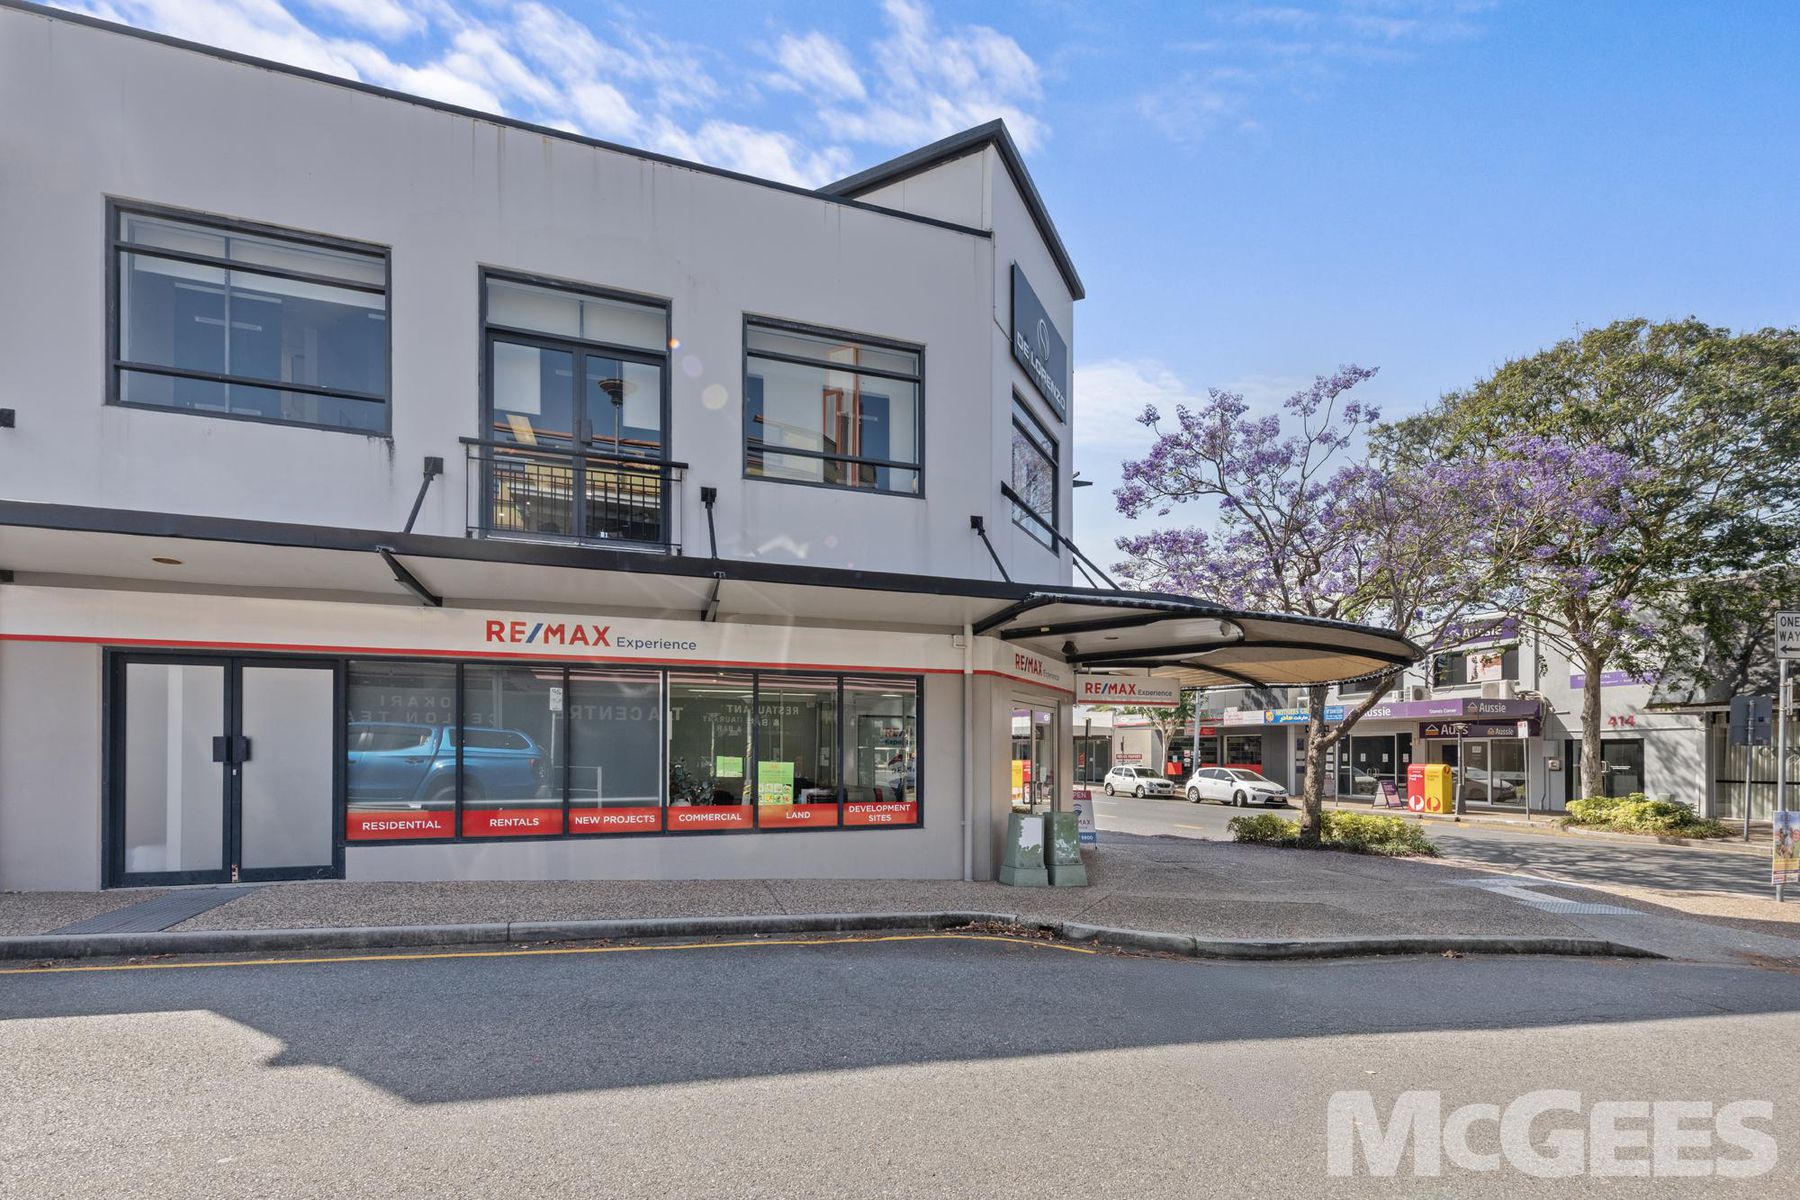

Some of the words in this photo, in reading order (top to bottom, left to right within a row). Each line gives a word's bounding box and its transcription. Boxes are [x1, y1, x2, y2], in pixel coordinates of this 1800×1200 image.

[1017, 331, 1029, 359] DE
[1030, 350, 1066, 410] LORENZO
[1780, 616, 1800, 627] ONE
[485, 619, 611, 647] RE/MAX
[616, 636, 697, 651] Experience
[1779, 631, 1800, 642] WAY
[1015, 653, 1043, 676] RE/MAX
[1085, 682, 1136, 696] RE/MAX
[1137, 688, 1173, 697] Experience
[1363, 706, 1391, 718] ussie
[1479, 702, 1506, 714] Aussie
[1607, 715, 1636, 728] 414
[1494, 727, 1514, 736] Aussie
[1072, 791, 1087, 799] PEN
[848, 804, 911, 814] DEVELOPMENT
[575, 816, 602, 825] NEW
[603, 814, 656, 824] PROJECTS
[678, 812, 742, 822] COMMERCIAL
[786, 811, 811, 820] LAND
[868, 814, 892, 822] SITES
[362, 820, 441, 831] RESIDENTIAL
[489, 817, 539, 827] RENTALS
